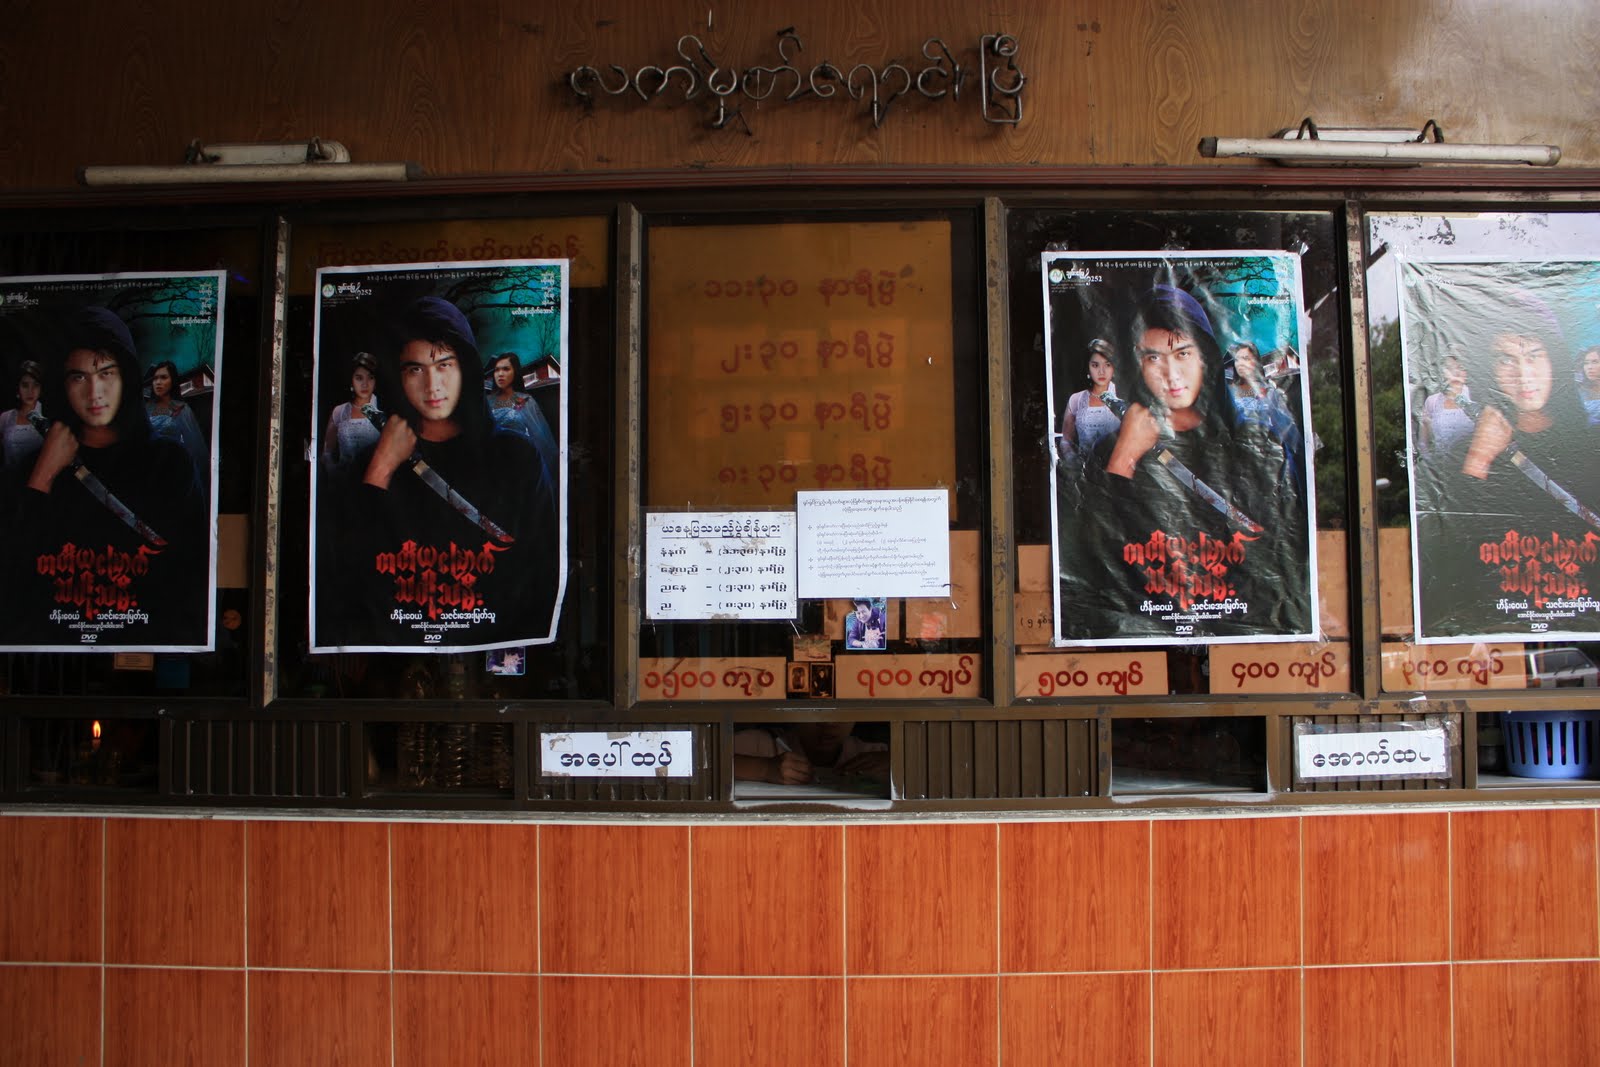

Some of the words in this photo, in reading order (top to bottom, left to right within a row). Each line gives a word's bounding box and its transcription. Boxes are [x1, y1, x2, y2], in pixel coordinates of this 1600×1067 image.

[1531, 622, 1550, 630] DVD
[722, 671, 775, 697] ကပ
[918, 655, 974, 694] ကျပ်
[1038, 669, 1089, 697] ၅၀၀
[1097, 661, 1144, 696] ကျပ်
[1288, 651, 1336, 688] ကျပ်
[1312, 738, 1432, 768] အောက်ထ
